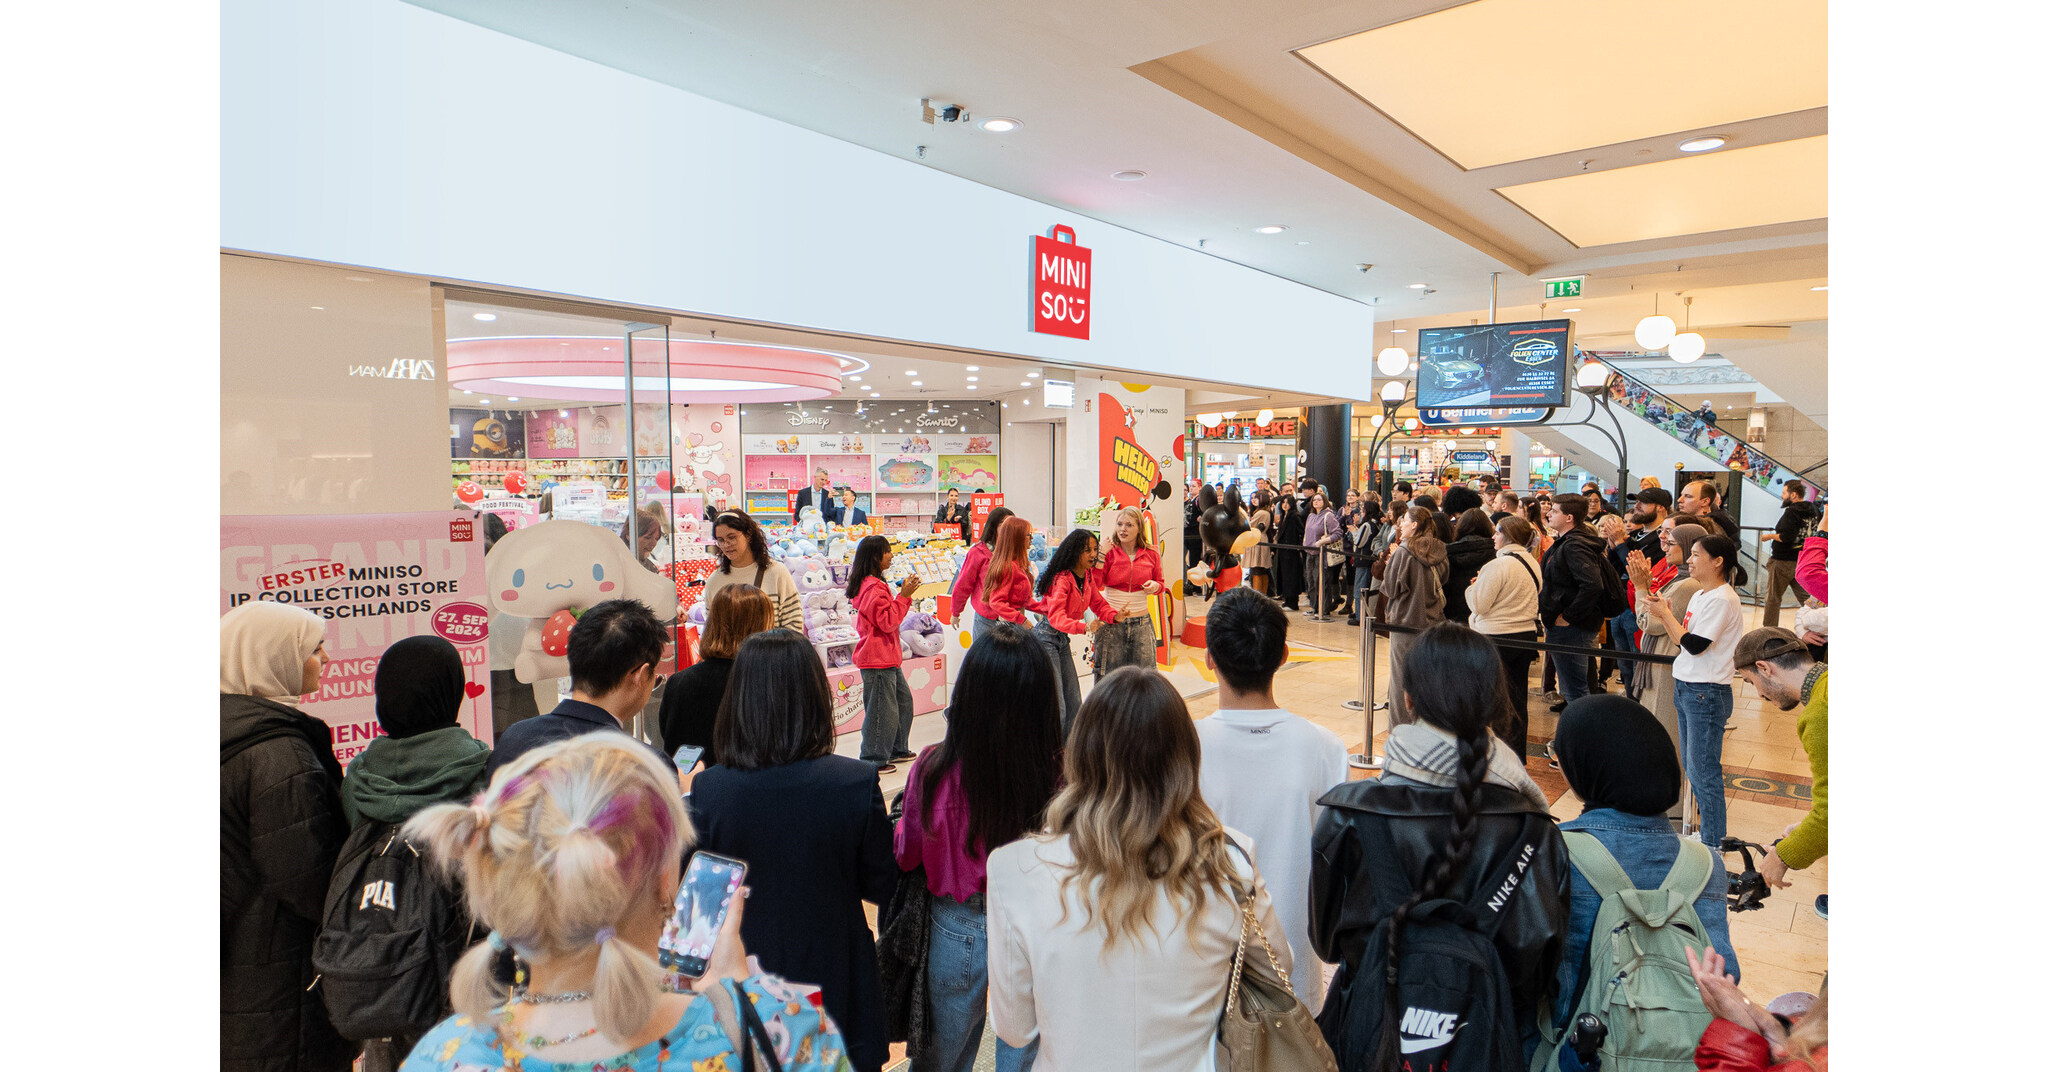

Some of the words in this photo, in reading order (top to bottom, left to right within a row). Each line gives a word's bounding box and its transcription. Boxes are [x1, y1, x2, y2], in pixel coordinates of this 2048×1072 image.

[1042, 252, 1086, 289] MINI
[785, 410, 831, 431] Disney
[1113, 436, 1155, 482] HELLO
[1456, 453, 1486, 461] Kiddieland
[1117, 464, 1150, 496] MINISO
[451, 524, 471, 532] MINI
[261, 562, 346, 591] ERSTER
[348, 564, 423, 581] MINISO
[230, 592, 252, 608] IP
[259, 584, 391, 604] COLLECTION
[397, 580, 459, 596] STORE
[445, 624, 482, 637] 2024
[845, 699, 864, 716] chara
[1487, 873, 1519, 912] NIKE
[1516, 844, 1535, 874] AIR
[1400, 1006, 1459, 1040] NIKE
